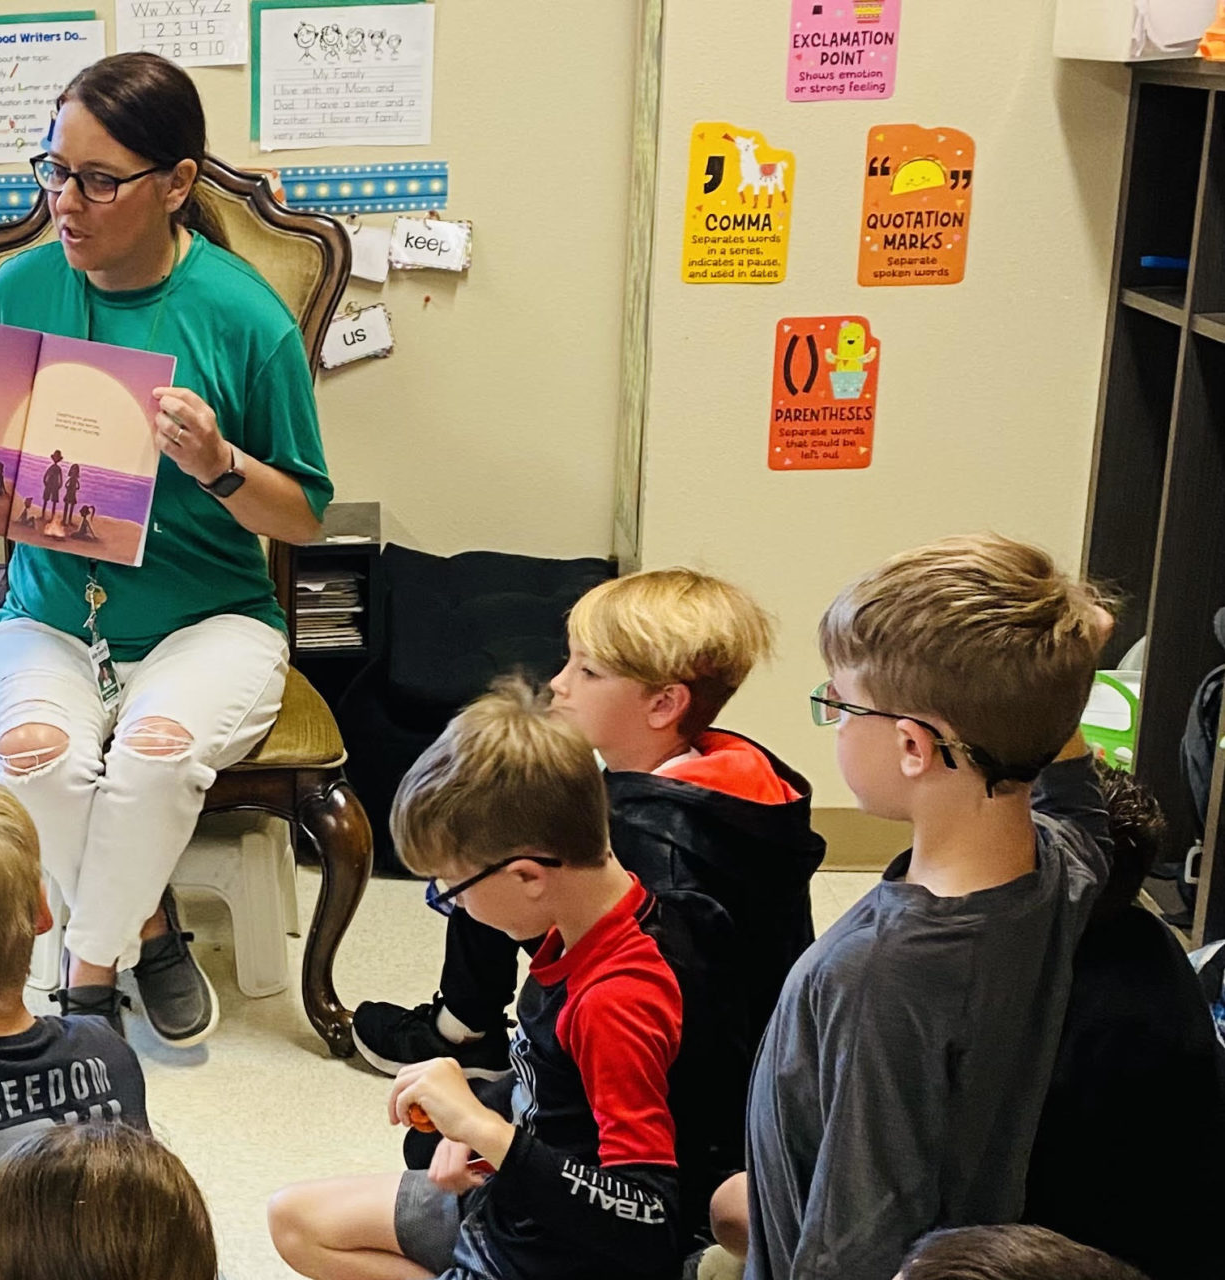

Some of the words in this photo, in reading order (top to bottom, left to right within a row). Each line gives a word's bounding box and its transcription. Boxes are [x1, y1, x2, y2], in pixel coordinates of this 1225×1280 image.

[131, 2, 158, 17] Ww
[166, 0, 181, 16] Xx
[189, 0, 206, 16] Yy
[213, 0, 231, 13] Zz
[156, 22, 165, 37] 2
[174, 22, 182, 36] 3
[190, 21, 198, 35] 4
[207, 20, 216, 34] 5
[20, 32, 60, 43] Writers
[793, 31, 894, 48] EXCLAMATION
[157, 43, 164, 57] 7
[174, 43, 181, 57] 8
[190, 42, 198, 56] 9
[209, 41, 224, 56] 10
[820, 50, 865, 65] POINT
[313, 68, 328, 80] My
[335, 68, 365, 80] Family
[799, 71, 834, 81] Shows
[838, 69, 883, 79] emotion
[326, 86, 340, 95] my
[345, 82, 371, 93] Mom
[376, 81, 394, 92] and
[794, 85, 806, 93] or
[810, 83, 845, 94] strong
[849, 81, 886, 93] feeling
[705, 213, 772, 231] COMMA
[867, 211, 965, 229] QUOTATION
[404, 232, 451, 256] keep
[691, 235, 744, 245] Separates
[747, 234, 781, 243] words
[883, 232, 943, 250] MARKS
[707, 246, 717, 255] in
[720, 247, 727, 255] a
[688, 258, 734, 267] indicates
[738, 259, 744, 267] a
[887, 256, 938, 267] Separate
[688, 269, 708, 278] and
[710, 269, 735, 278] used
[737, 269, 747, 278] in
[750, 268, 779, 278] dates
[873, 269, 911, 279] spoken
[914, 268, 949, 277] words
[343, 328, 367, 346] us
[775, 406, 872, 422] PARENTHESES
[778, 428, 827, 437] Separate
[831, 426, 865, 435] words
[786, 439, 807, 448] that
[811, 438, 840, 447] could
[843, 438, 856, 446] be
[801, 450, 817, 459] left
[822, 450, 839, 459] out
[561, 1171, 664, 1224] TBALL
